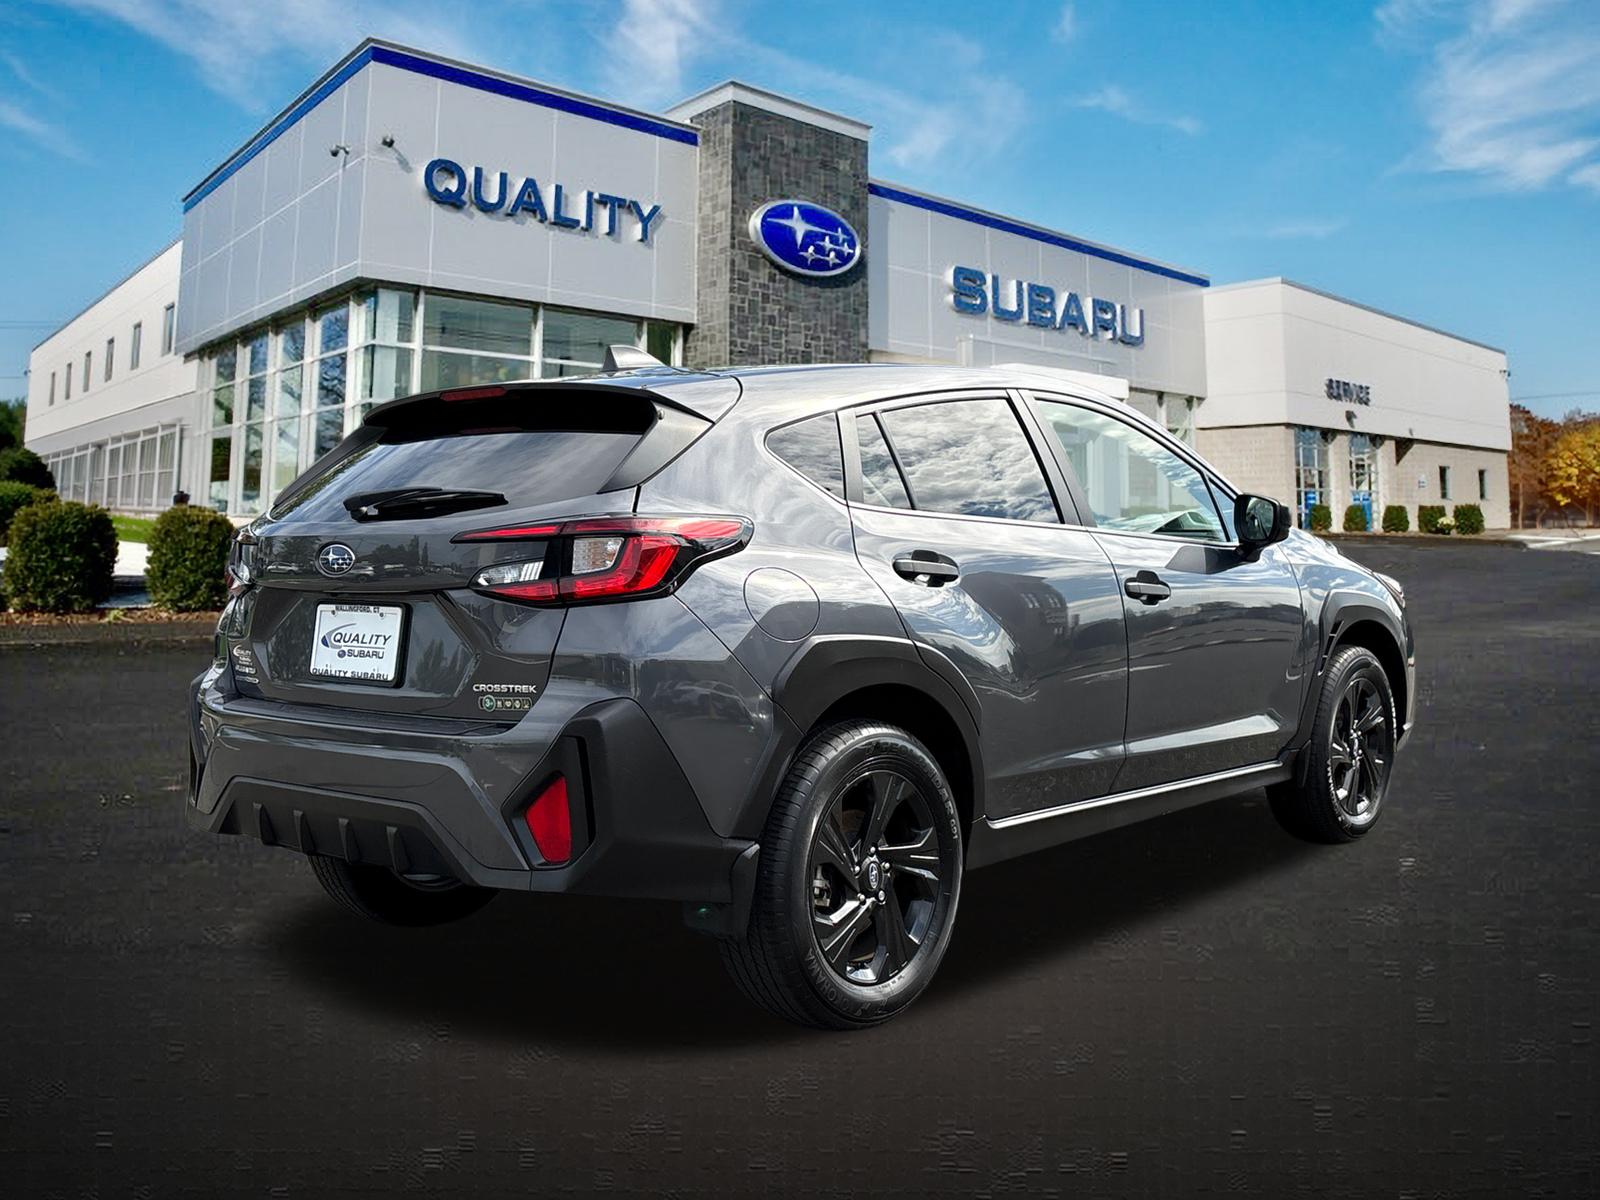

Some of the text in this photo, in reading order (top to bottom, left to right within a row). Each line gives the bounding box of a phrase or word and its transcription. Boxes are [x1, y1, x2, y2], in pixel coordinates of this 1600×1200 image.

[424, 157, 663, 242] QUALITY
[949, 264, 1145, 347] SUBARU
[1325, 378, 1370, 406] SERVICE
[333, 632, 391, 646] QUALITY
[347, 649, 385, 659] SUBARU
[312, 667, 389, 681] QUALITY SUBARU
[472, 684, 537, 693] CROSSTREK
[804, 947, 858, 1012] OKOHAMA
